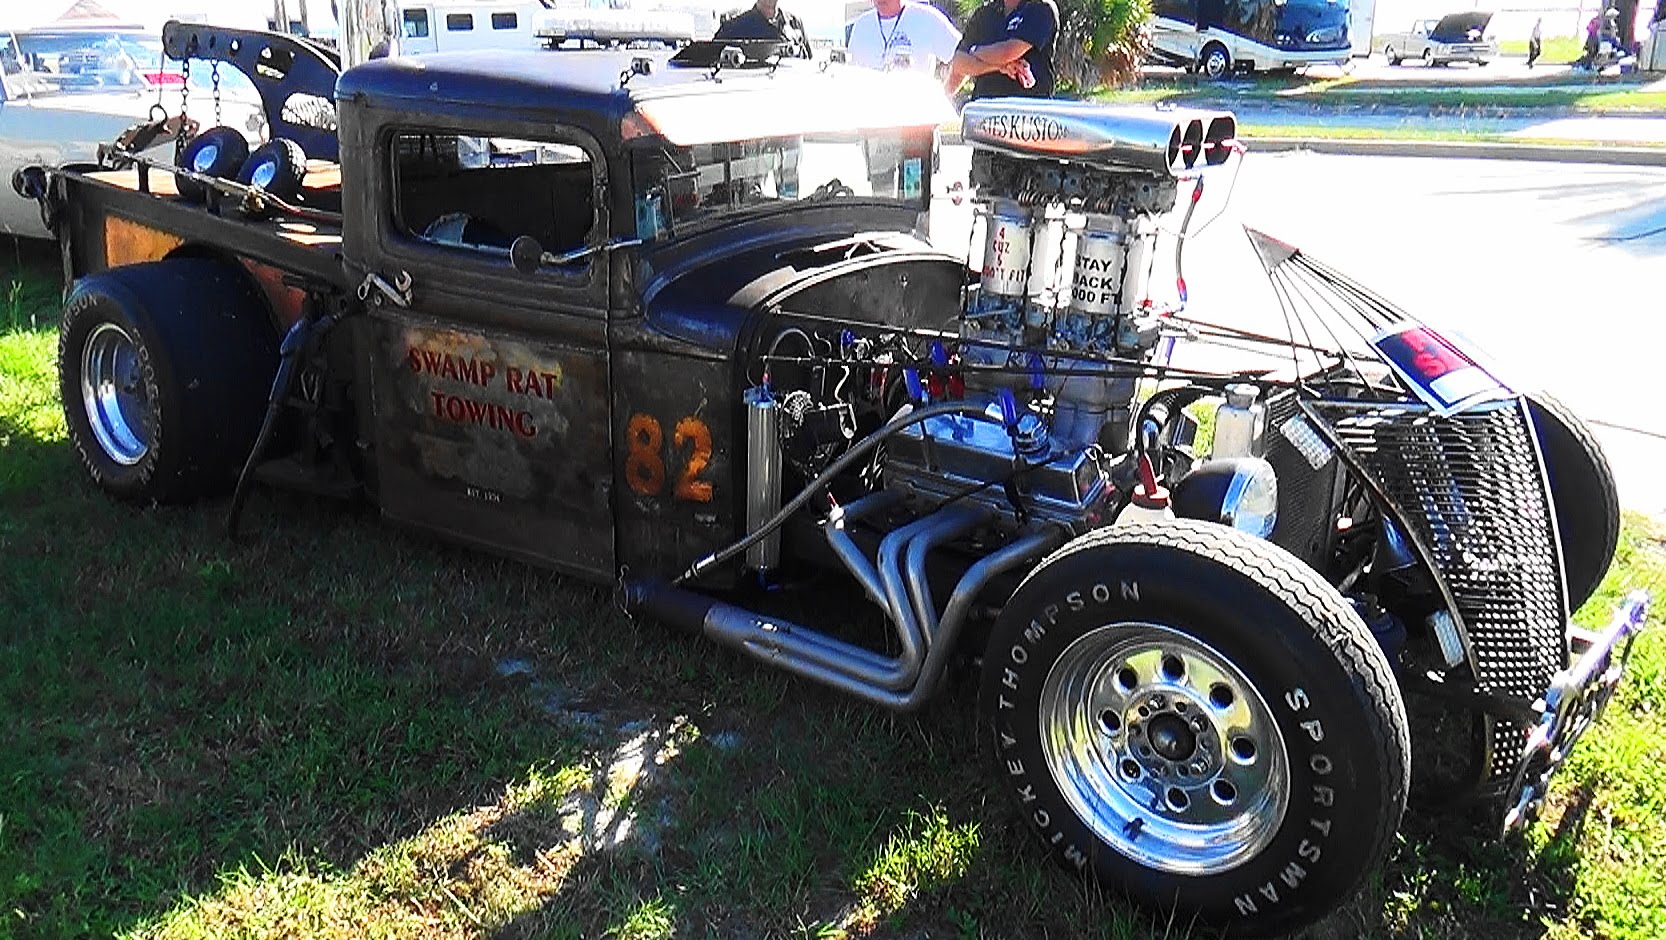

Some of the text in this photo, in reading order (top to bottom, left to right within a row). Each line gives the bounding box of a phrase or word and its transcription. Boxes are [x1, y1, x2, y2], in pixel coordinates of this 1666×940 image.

[1009, 269, 1025, 282] FIT
[1075, 254, 1112, 272] STAY
[408, 346, 558, 401] SWAMP RAT
[431, 389, 537, 437] TOWING
[625, 412, 714, 504] 82
[999, 580, 1140, 869] MICKEY THOMPSON
[1233, 687, 1335, 918] SPORTSMAN
